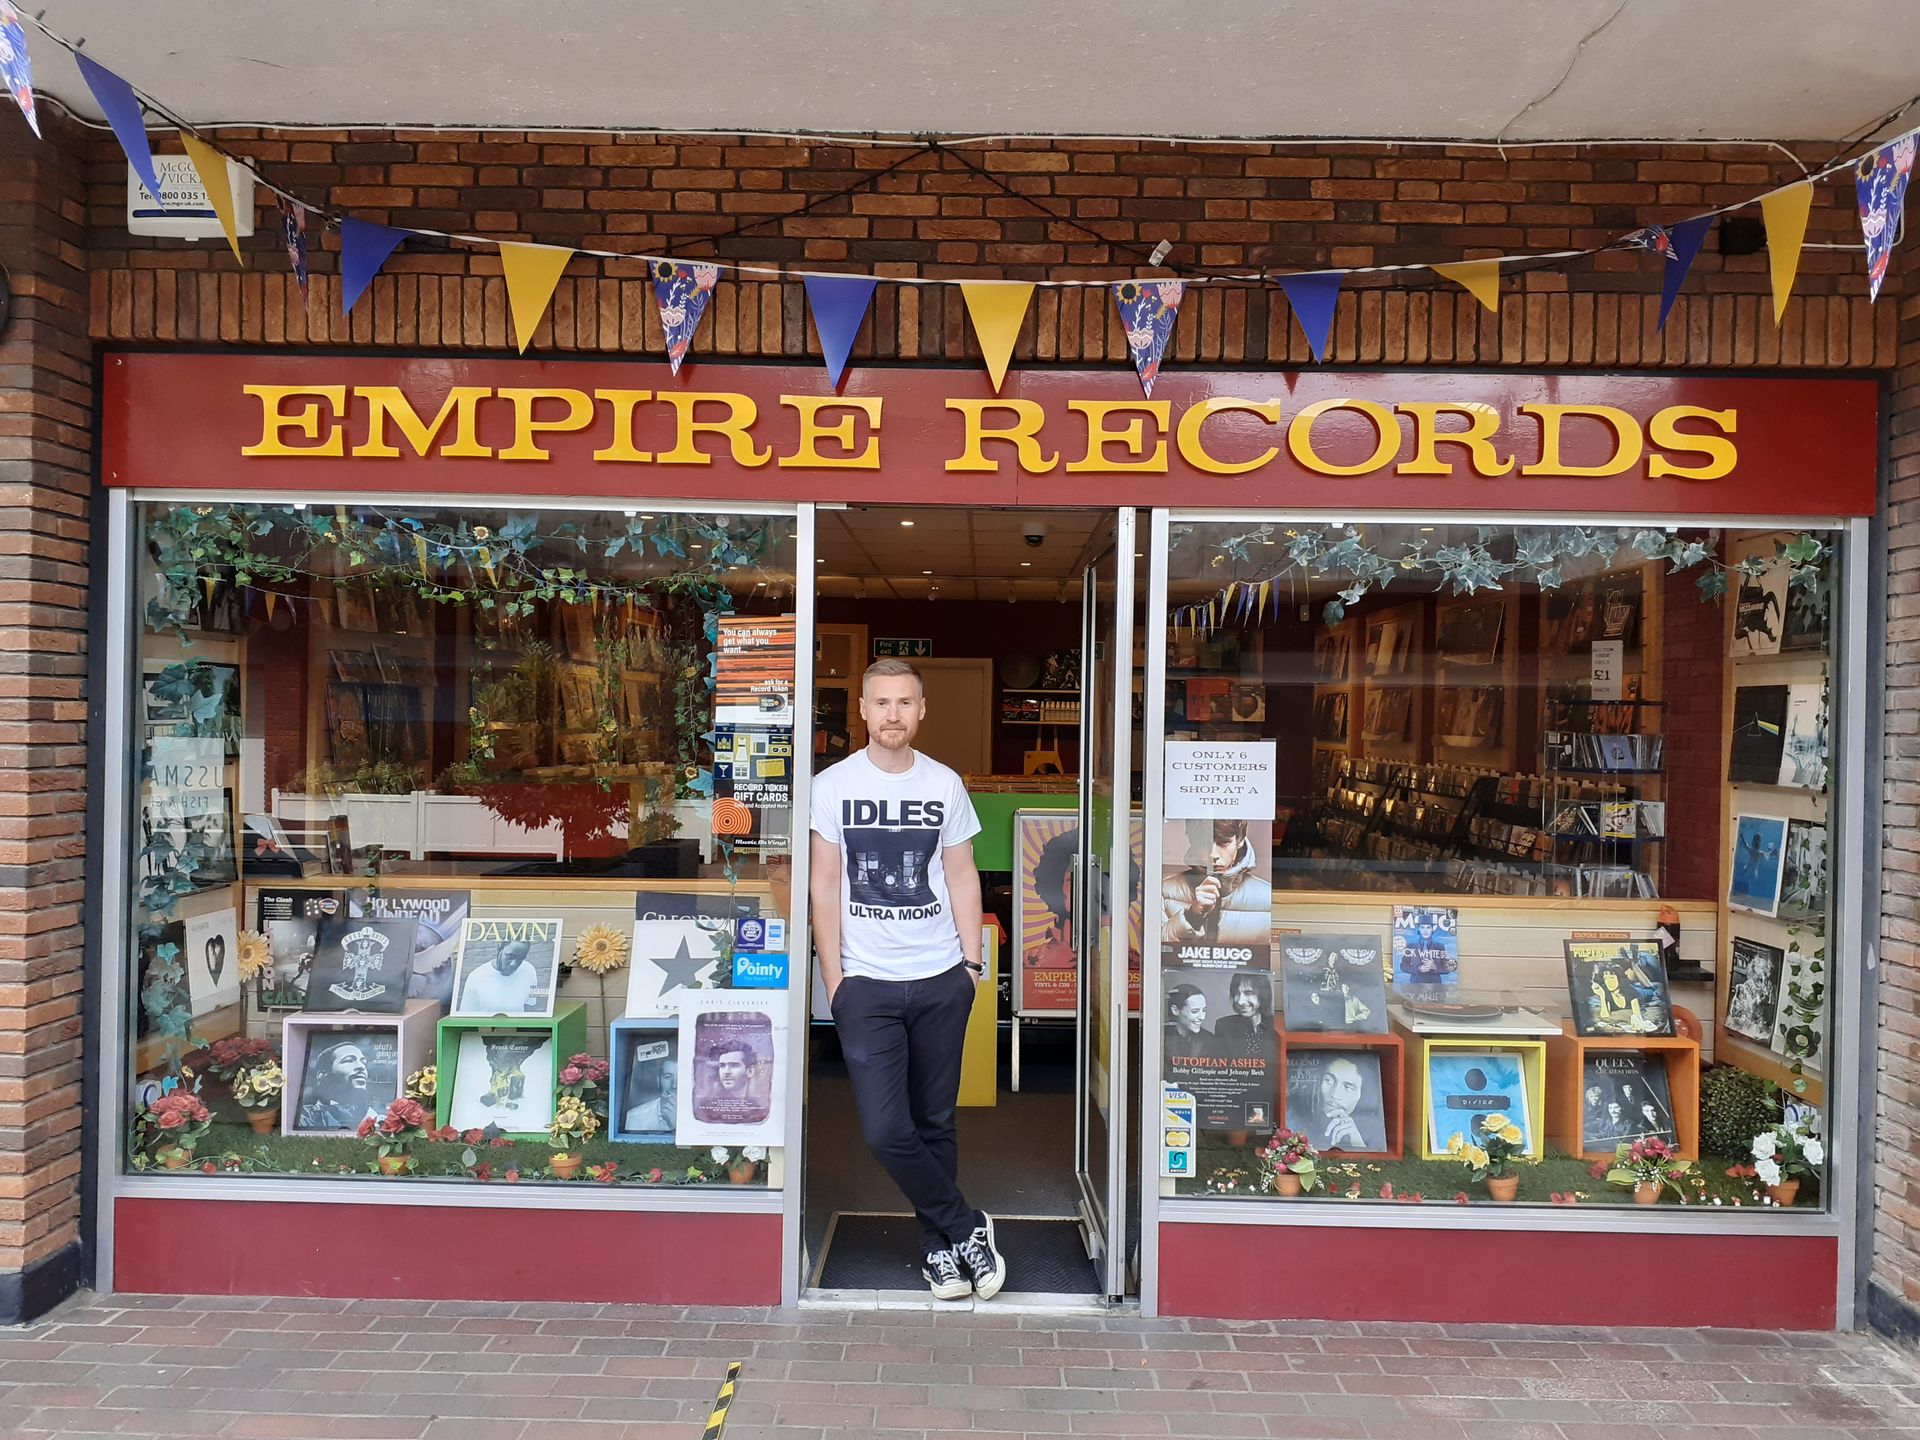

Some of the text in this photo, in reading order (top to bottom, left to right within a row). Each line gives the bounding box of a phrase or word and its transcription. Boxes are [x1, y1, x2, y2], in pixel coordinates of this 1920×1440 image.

[241, 384, 1738, 480] EMPIRE RECORDS
[723, 628, 736, 636] You
[752, 628, 777, 636] always
[1594, 669, 1611, 680] £1
[1193, 750, 1235, 759] ONLY
[1172, 762, 1267, 771] CUSTOMERS
[1193, 774, 1246, 782] IN THE
[734, 783, 789, 792] RECORD TOKEN
[1180, 785, 1258, 794] SHOP AT A
[733, 792, 788, 802] GIFT CARDS
[1200, 797, 1239, 805] TIME
[842, 799, 945, 827] IDLES
[366, 897, 450, 912] HOLLYWOOD
[849, 903, 942, 920] ULTRA MONO
[1178, 947, 1253, 961] JAKE BUGG
[737, 957, 783, 979] Pointy
[1172, 1056, 1266, 1068] UTOPIAN ASHES
[1595, 1058, 1634, 1070] QUEEN
[1172, 1067, 1189, 1075] Bobby
[1191, 1067, 1216, 1076] Gillespie
